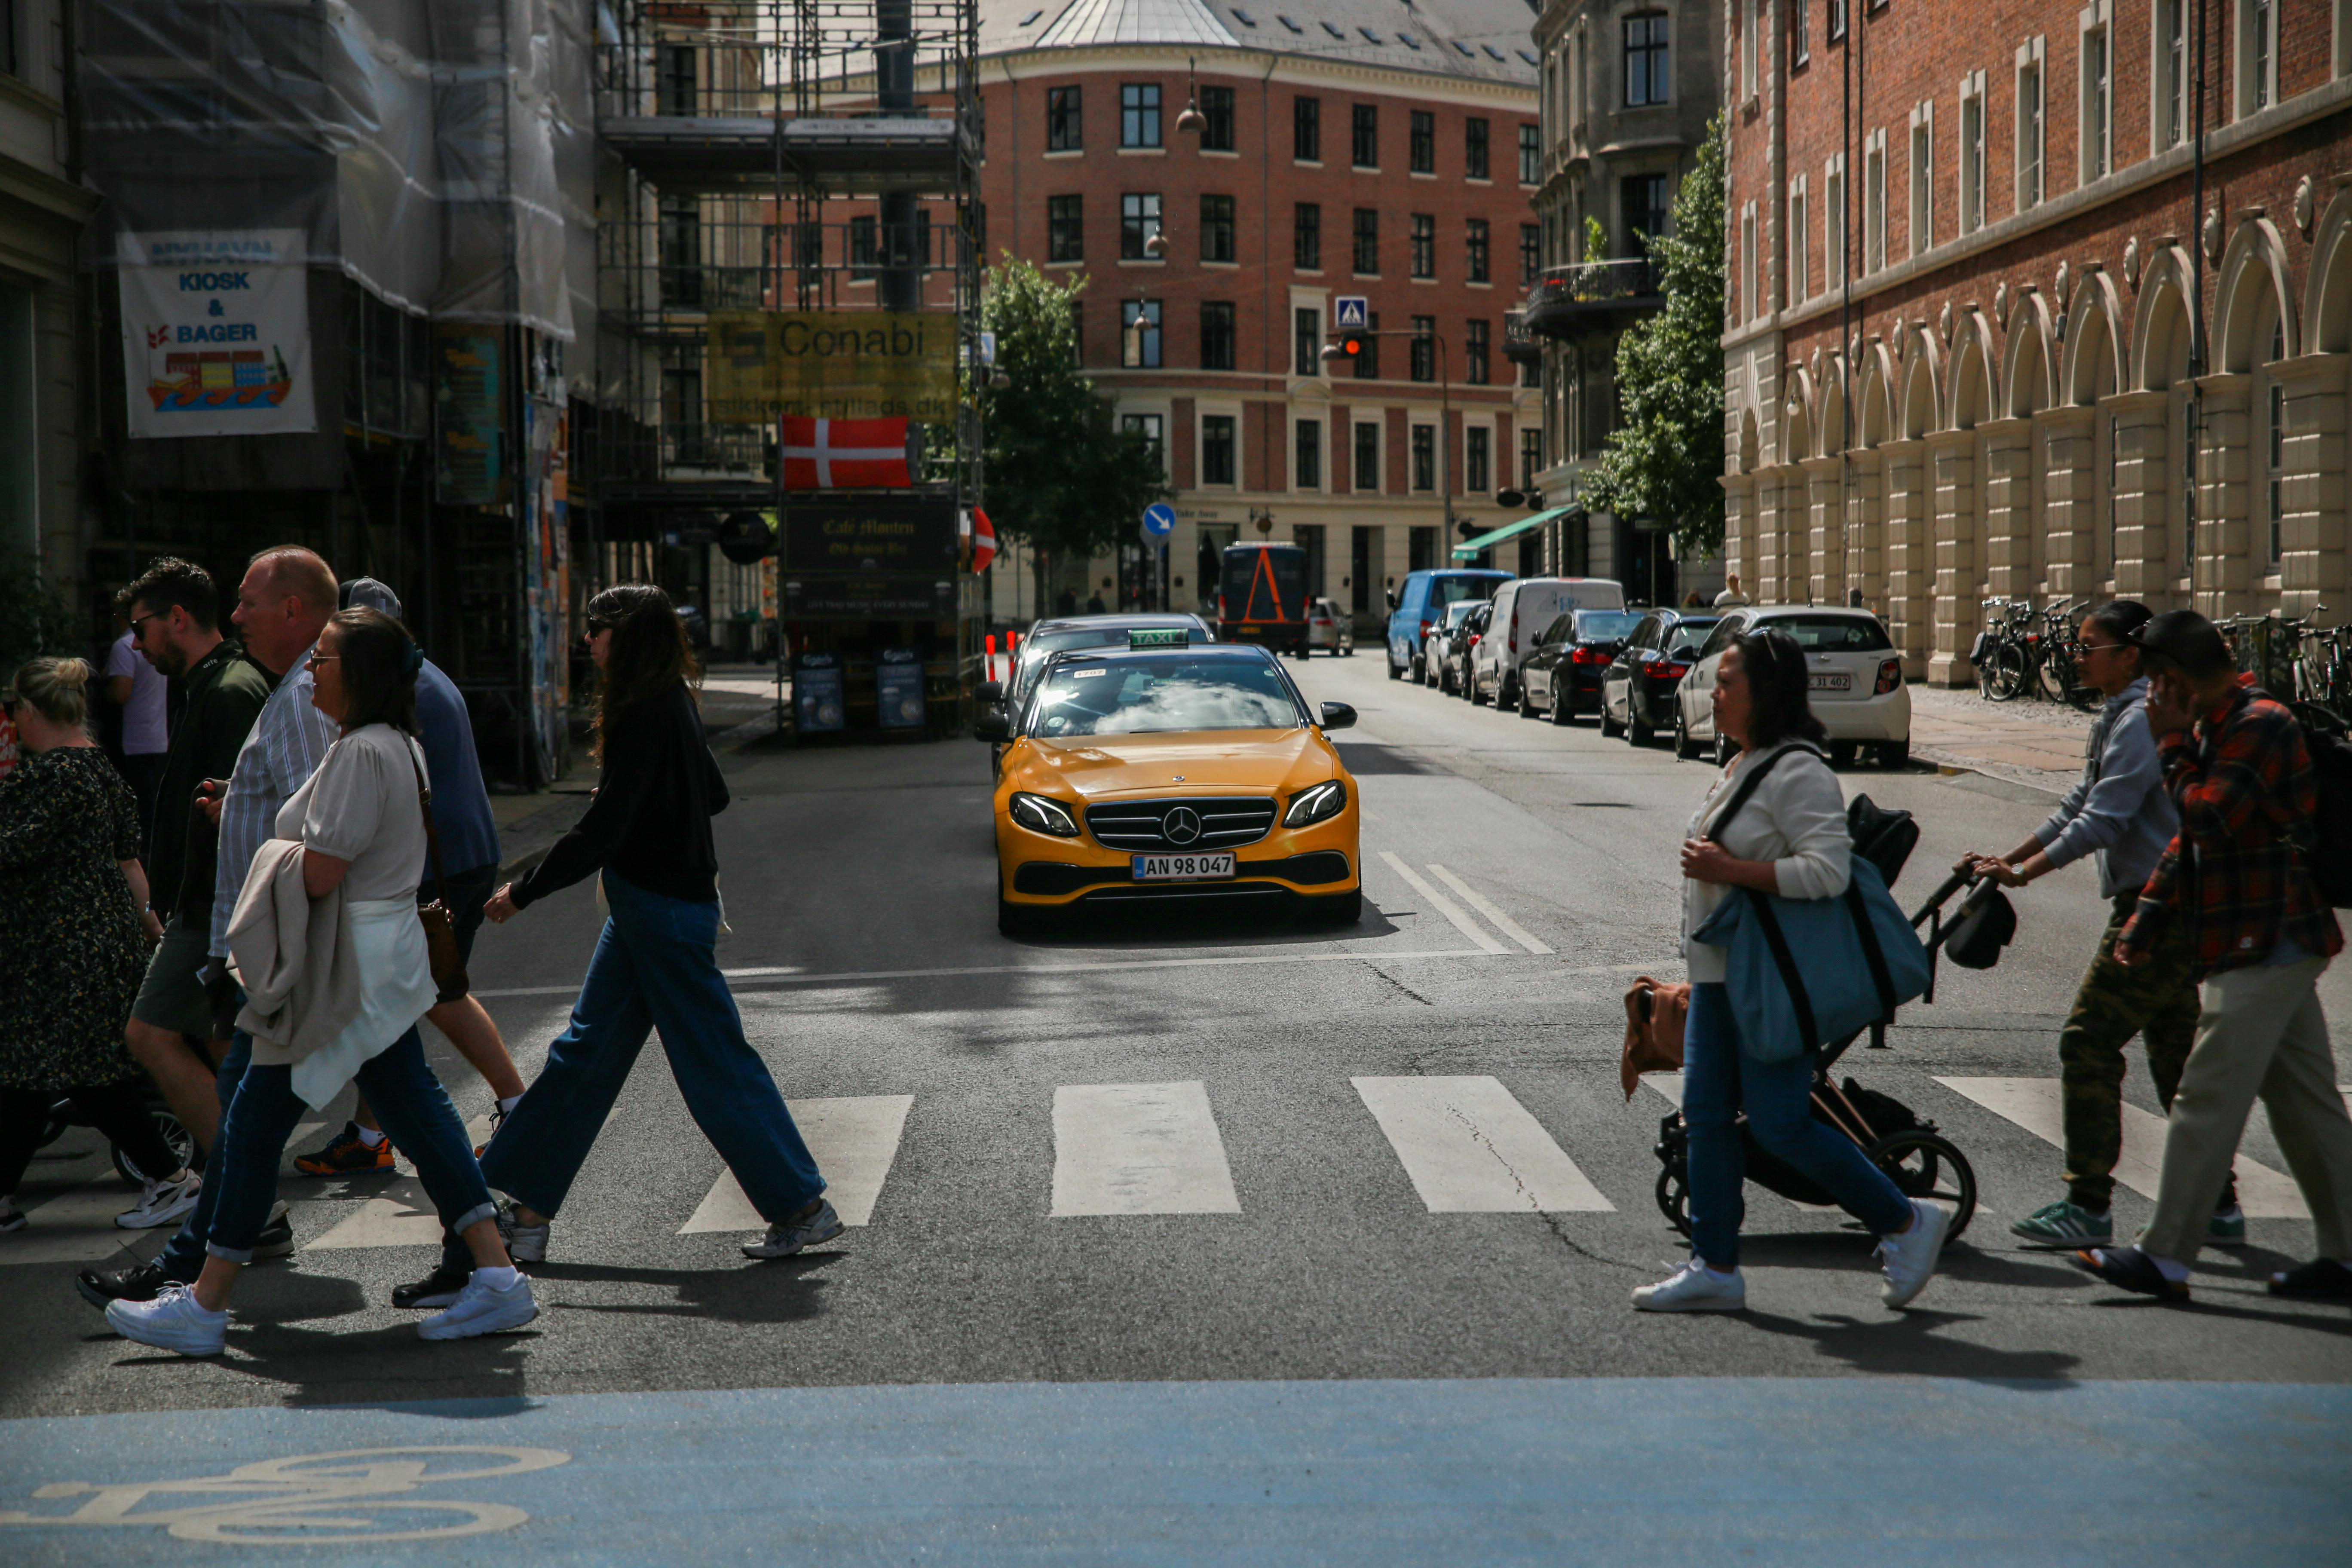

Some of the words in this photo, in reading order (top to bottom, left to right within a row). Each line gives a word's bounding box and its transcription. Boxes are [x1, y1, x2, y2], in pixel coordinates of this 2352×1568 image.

[179, 272, 250, 291] KIOSK
[208, 299, 224, 316] &
[177, 324, 257, 343] BAGER
[780, 321, 924, 356] Conabi
[1134, 633, 1173, 644] TAXI
[203, 658, 218, 668] arte
[1816, 677, 1826, 686] 31
[1830, 677, 1848, 686] 402
[1146, 859, 1169, 875] AN
[1174, 858, 1195, 874] 98
[1200, 857, 1231, 873] 047
